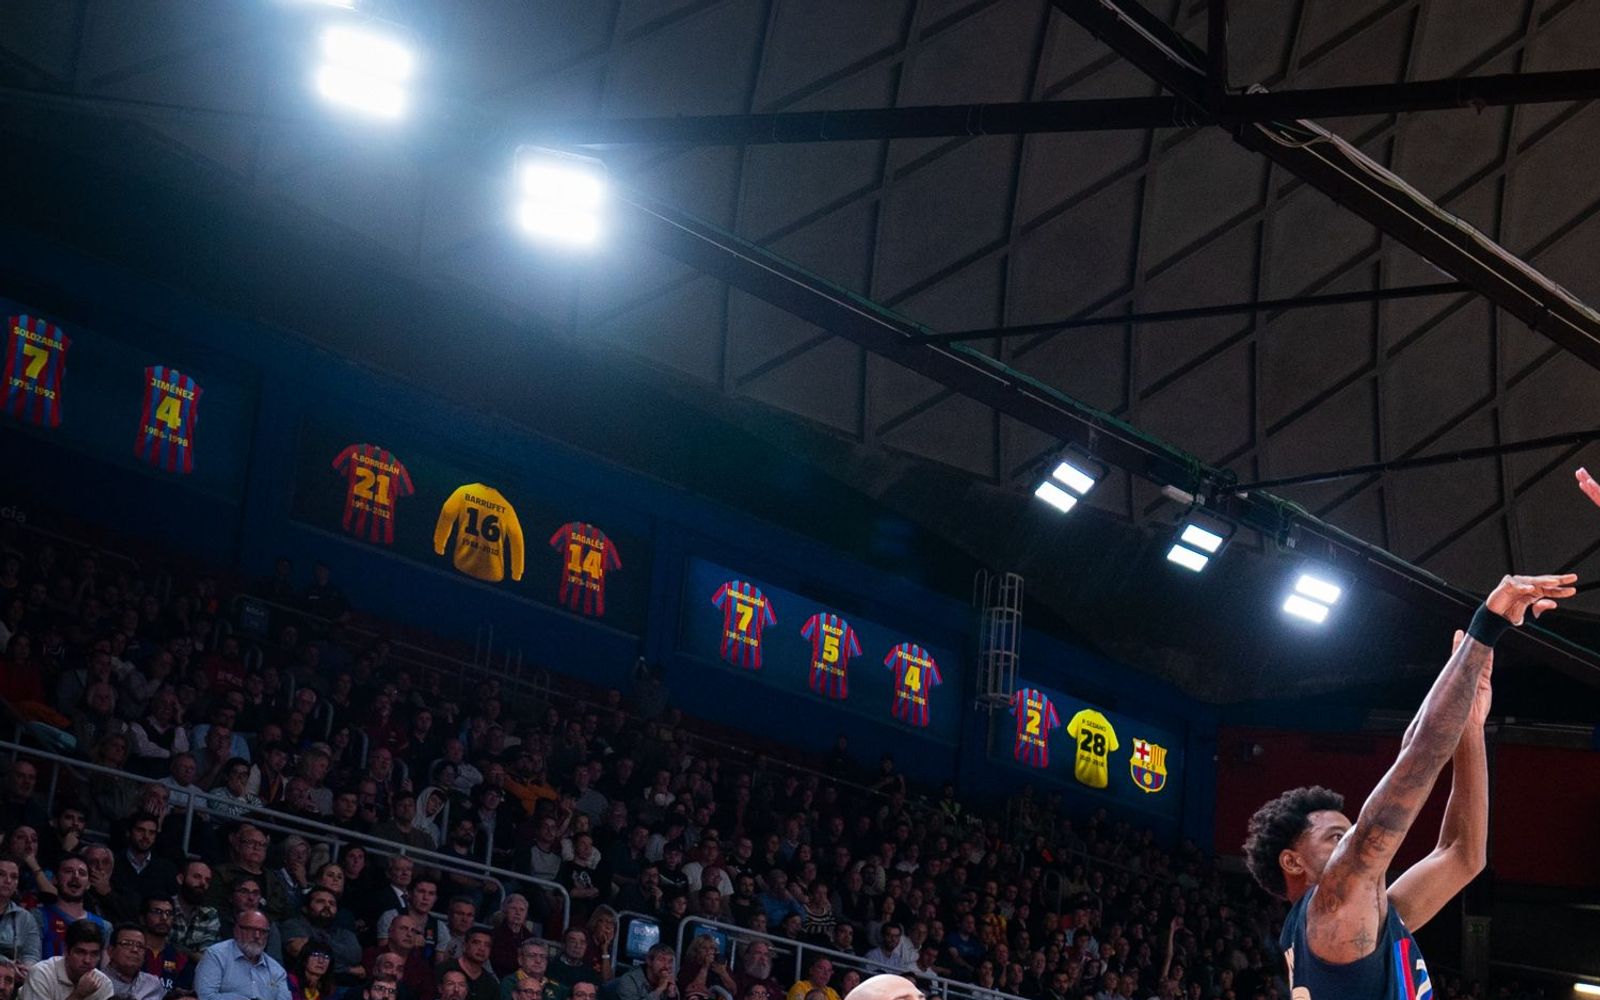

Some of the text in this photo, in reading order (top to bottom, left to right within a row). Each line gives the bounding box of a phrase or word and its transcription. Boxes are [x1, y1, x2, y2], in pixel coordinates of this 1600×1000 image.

[22, 343, 49, 379] 7
[151, 377, 195, 401] JIMÉNEZ
[156, 395, 182, 430] 4
[353, 466, 391, 506] 21
[465, 493, 506, 513] BARRUFET
[465, 507, 500, 542] 16
[568, 543, 603, 580] 14
[736, 602, 753, 632] 7
[823, 634, 840, 663] 5
[905, 664, 920, 692] 4
[1026, 709, 1042, 735] 2
[1080, 728, 1106, 757] 28
